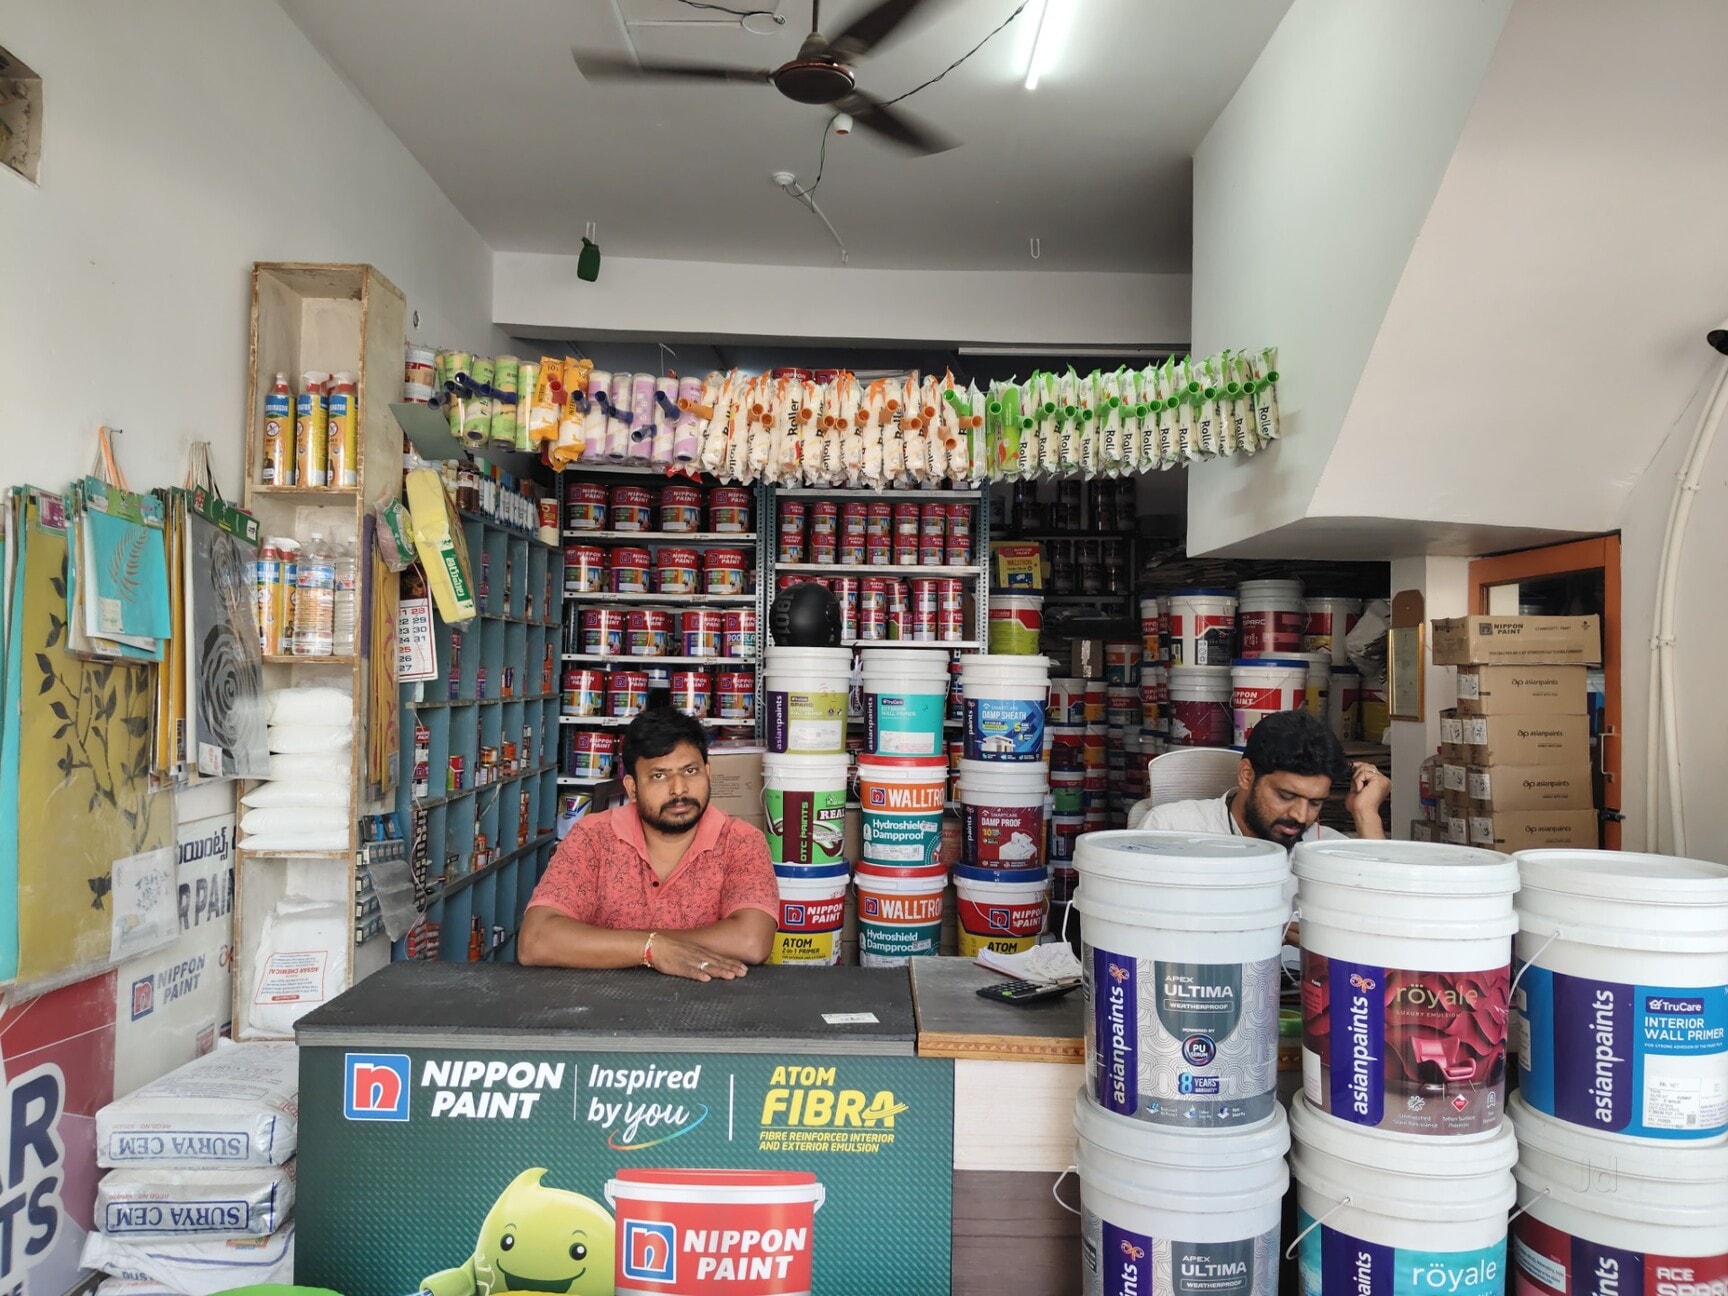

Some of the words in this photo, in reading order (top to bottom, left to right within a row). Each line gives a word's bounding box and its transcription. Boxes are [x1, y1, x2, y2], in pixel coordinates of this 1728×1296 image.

[787, 398, 799, 436] Roller
[1260, 405, 1272, 436] Roller
[1123, 434, 1132, 462] Rolle
[1144, 430, 1152, 456] Rolle
[1161, 428, 1170, 456] Rolle
[1180, 428, 1188, 455] Rolle
[412, 616, 427, 624] 29
[413, 635, 426, 643] 31
[775, 695, 784, 750] asianpaints
[982, 711, 1000, 719] DAMP
[1001, 712, 1027, 720] SHEATH
[1536, 780, 1570, 788] asianpaints
[888, 788, 944, 807] WALLTRO
[800, 801, 808, 838] PAINTS
[981, 818, 1000, 826] DAMP
[1001, 819, 1022, 827] PROOF
[873, 829, 925, 841] Dampproof
[800, 840, 808, 861] OTC
[195, 868, 235, 927] PAIN
[807, 903, 843, 915] NIPPON
[812, 912, 841, 924] PAINT
[881, 898, 942, 919] WALLTRO
[782, 938, 812, 948] ATOM
[867, 929, 918, 942] Hydroshield
[867, 939, 914, 953] Dampproo
[988, 942, 1018, 952] ATOM
[157, 953, 206, 989] NIPPON
[163, 973, 201, 1005] PAINT
[1164, 984, 1233, 998] ULTIMA
[1662, 1001, 1702, 1012] TruCare
[1644, 1016, 1705, 1029] INTERIOR
[1644, 1029, 1684, 1041] WALL
[1687, 1028, 1724, 1041] PRIMER
[1108, 986, 1132, 1104] asianpaints
[1193, 1044, 1205, 1053] PU
[1348, 996, 1378, 1115] asianpaints
[1588, 990, 1625, 1123] asianpaints
[421, 1060, 565, 1089] NIPPON
[588, 1065, 701, 1094] Inspired
[770, 1066, 836, 1086] ATOM
[1179, 1072, 1193, 1094] 8
[1194, 1078, 1217, 1088] YEARS
[431, 1091, 540, 1119] PAINT
[761, 1088, 900, 1127] FIBRA
[587, 1099, 622, 1127] by
[621, 1100, 690, 1143] you
[119, 1136, 165, 1156] CEM
[172, 1136, 241, 1156] SURYA
[759, 1141, 780, 1151] AND
[782, 1142, 829, 1152] EXTERIOR
[831, 1142, 880, 1152] EMULSION
[760, 1131, 787, 1141] FIBRE
[789, 1132, 848, 1142] REINFORCED
[850, 1133, 895, 1143] INTERIOR
[116, 1207, 164, 1227] CEM
[170, 1207, 241, 1226] SURYA
[683, 1228, 807, 1253] NIPPON
[697, 1255, 794, 1281] PAINT
[1181, 1262, 1247, 1277] ULTIMA
[1656, 1267, 1695, 1281] ACE
[1186, 1280, 1243, 1289] WEATHERPROOF
